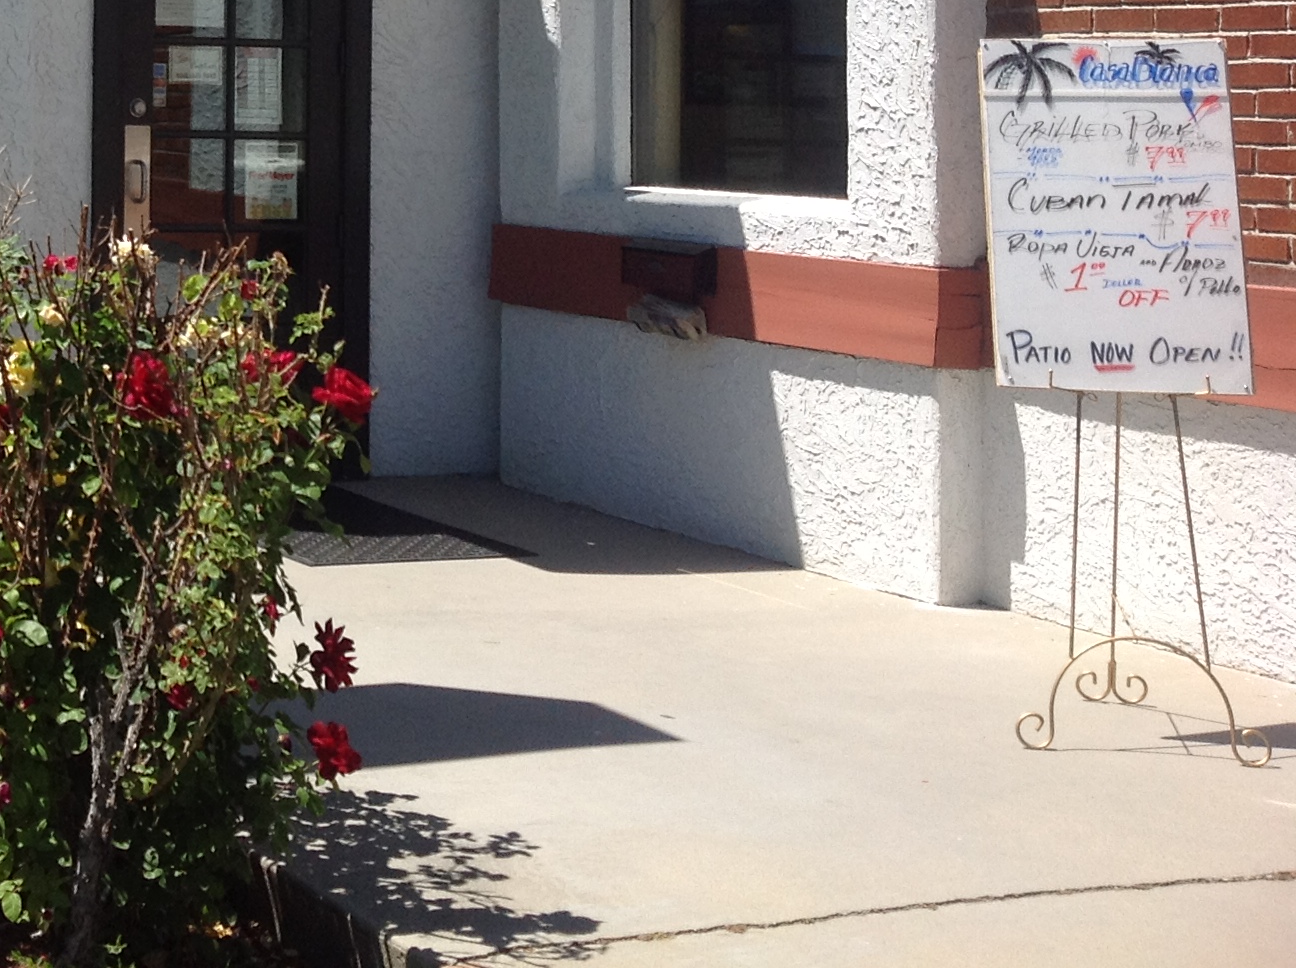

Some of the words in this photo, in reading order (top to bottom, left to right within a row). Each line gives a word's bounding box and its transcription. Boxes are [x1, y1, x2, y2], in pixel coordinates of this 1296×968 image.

[1123, 109, 1194, 142] PORK
[1007, 178, 1106, 212] CUBAN
[1118, 288, 1170, 307] OFF
[1006, 329, 1072, 365] PATIO
[1090, 340, 1134, 365] NOW
[1149, 336, 1221, 365] OPEN
